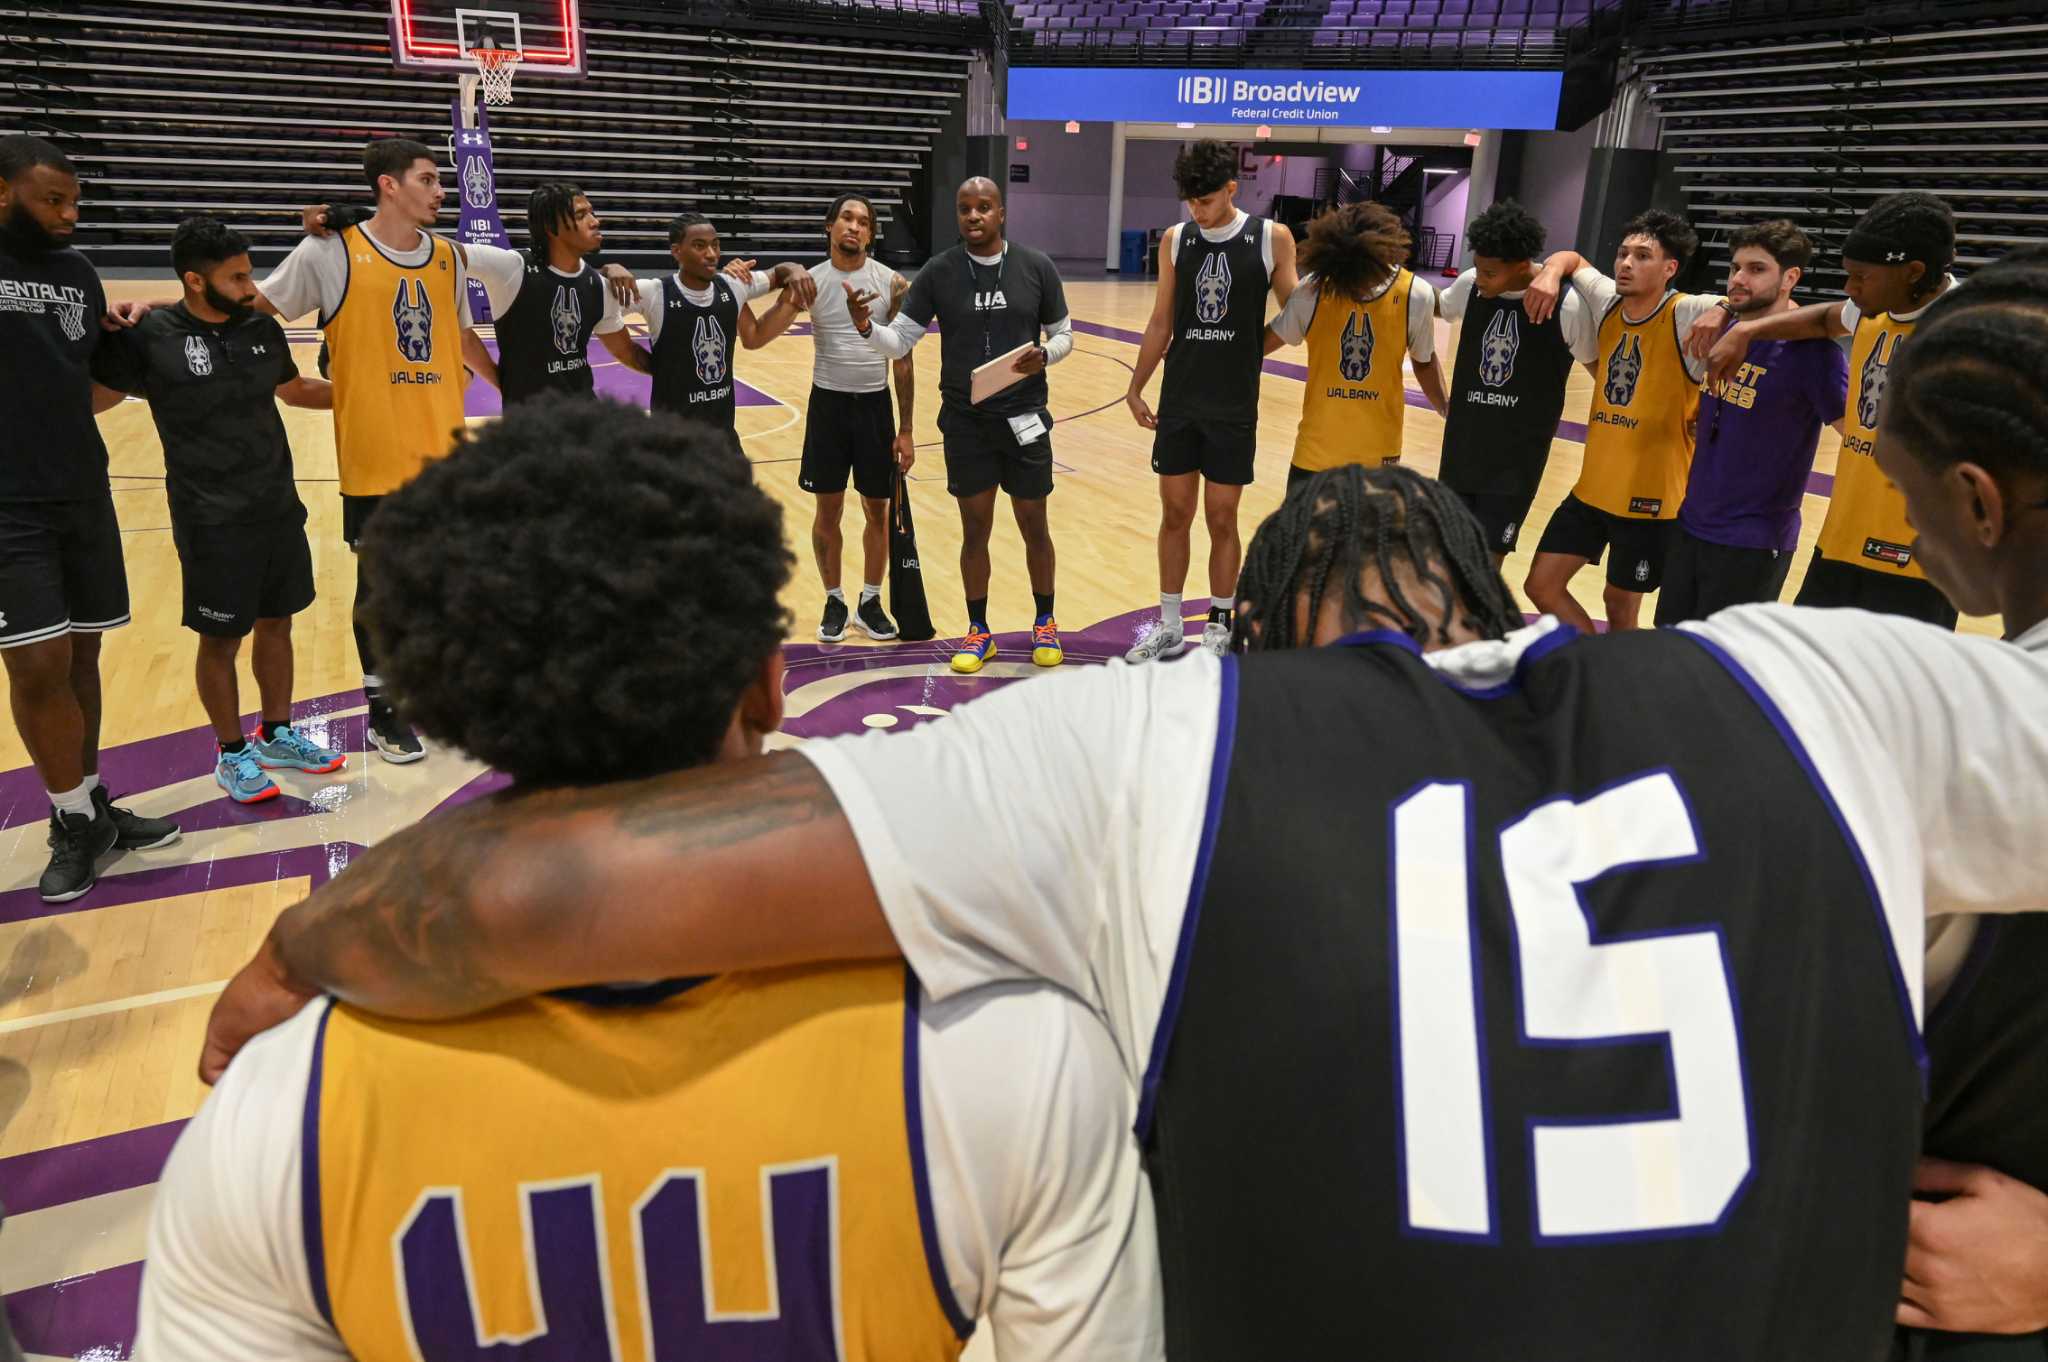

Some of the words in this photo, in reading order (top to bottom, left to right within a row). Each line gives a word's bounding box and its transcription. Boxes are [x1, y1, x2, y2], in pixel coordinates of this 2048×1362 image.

[1233, 80, 1360, 103] Broadview
[1231, 107, 1270, 119] Federal
[1271, 107, 1304, 119] Credit
[1306, 109, 1339, 120] Union
[1185, 328, 1236, 341] UALBANY
[689, 385, 731, 404] UALBANY
[1326, 387, 1380, 402] UALBANY
[1467, 390, 1519, 408] UALBANY
[1591, 411, 1639, 430] ALBANY
[1387, 765, 1759, 1247] 15
